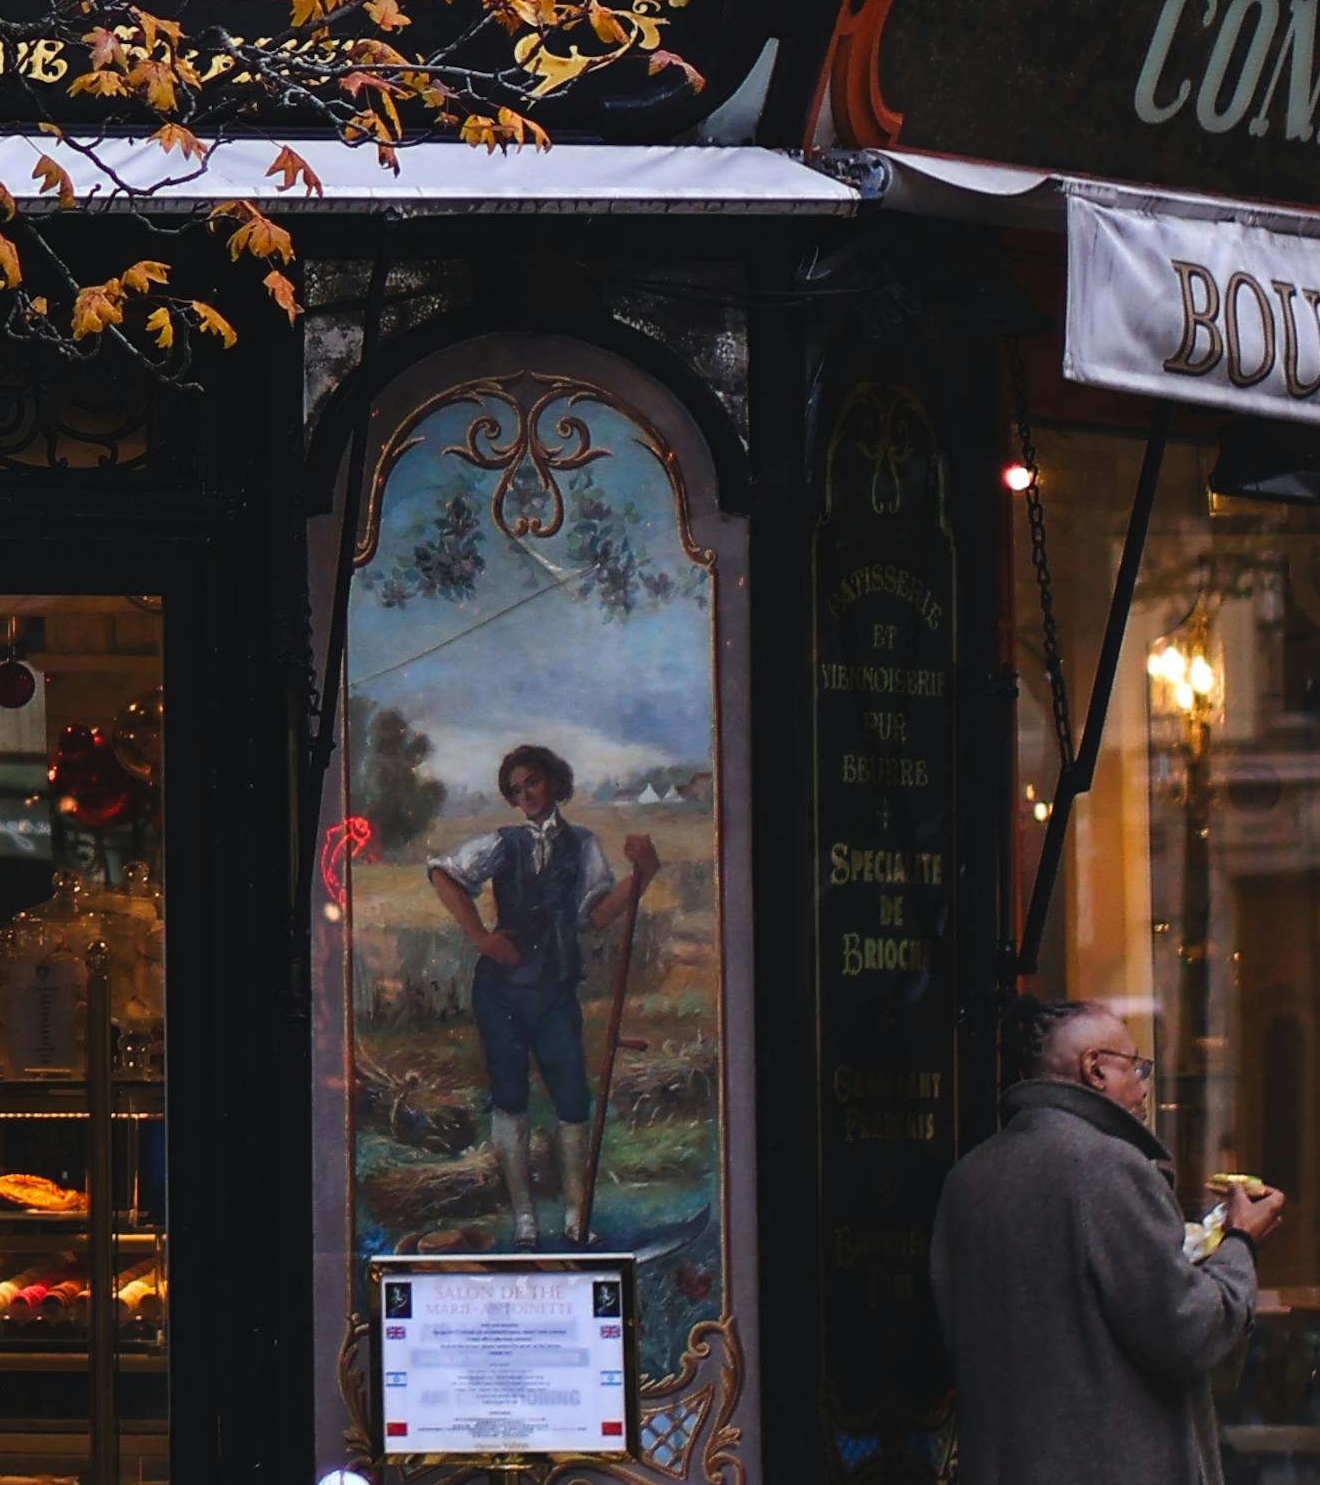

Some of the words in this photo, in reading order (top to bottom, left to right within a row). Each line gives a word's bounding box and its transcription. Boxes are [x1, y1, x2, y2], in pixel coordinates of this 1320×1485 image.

[826, 563, 943, 631] PATISSERIE
[871, 622, 897, 650] ET
[878, 894, 905, 928] DE
